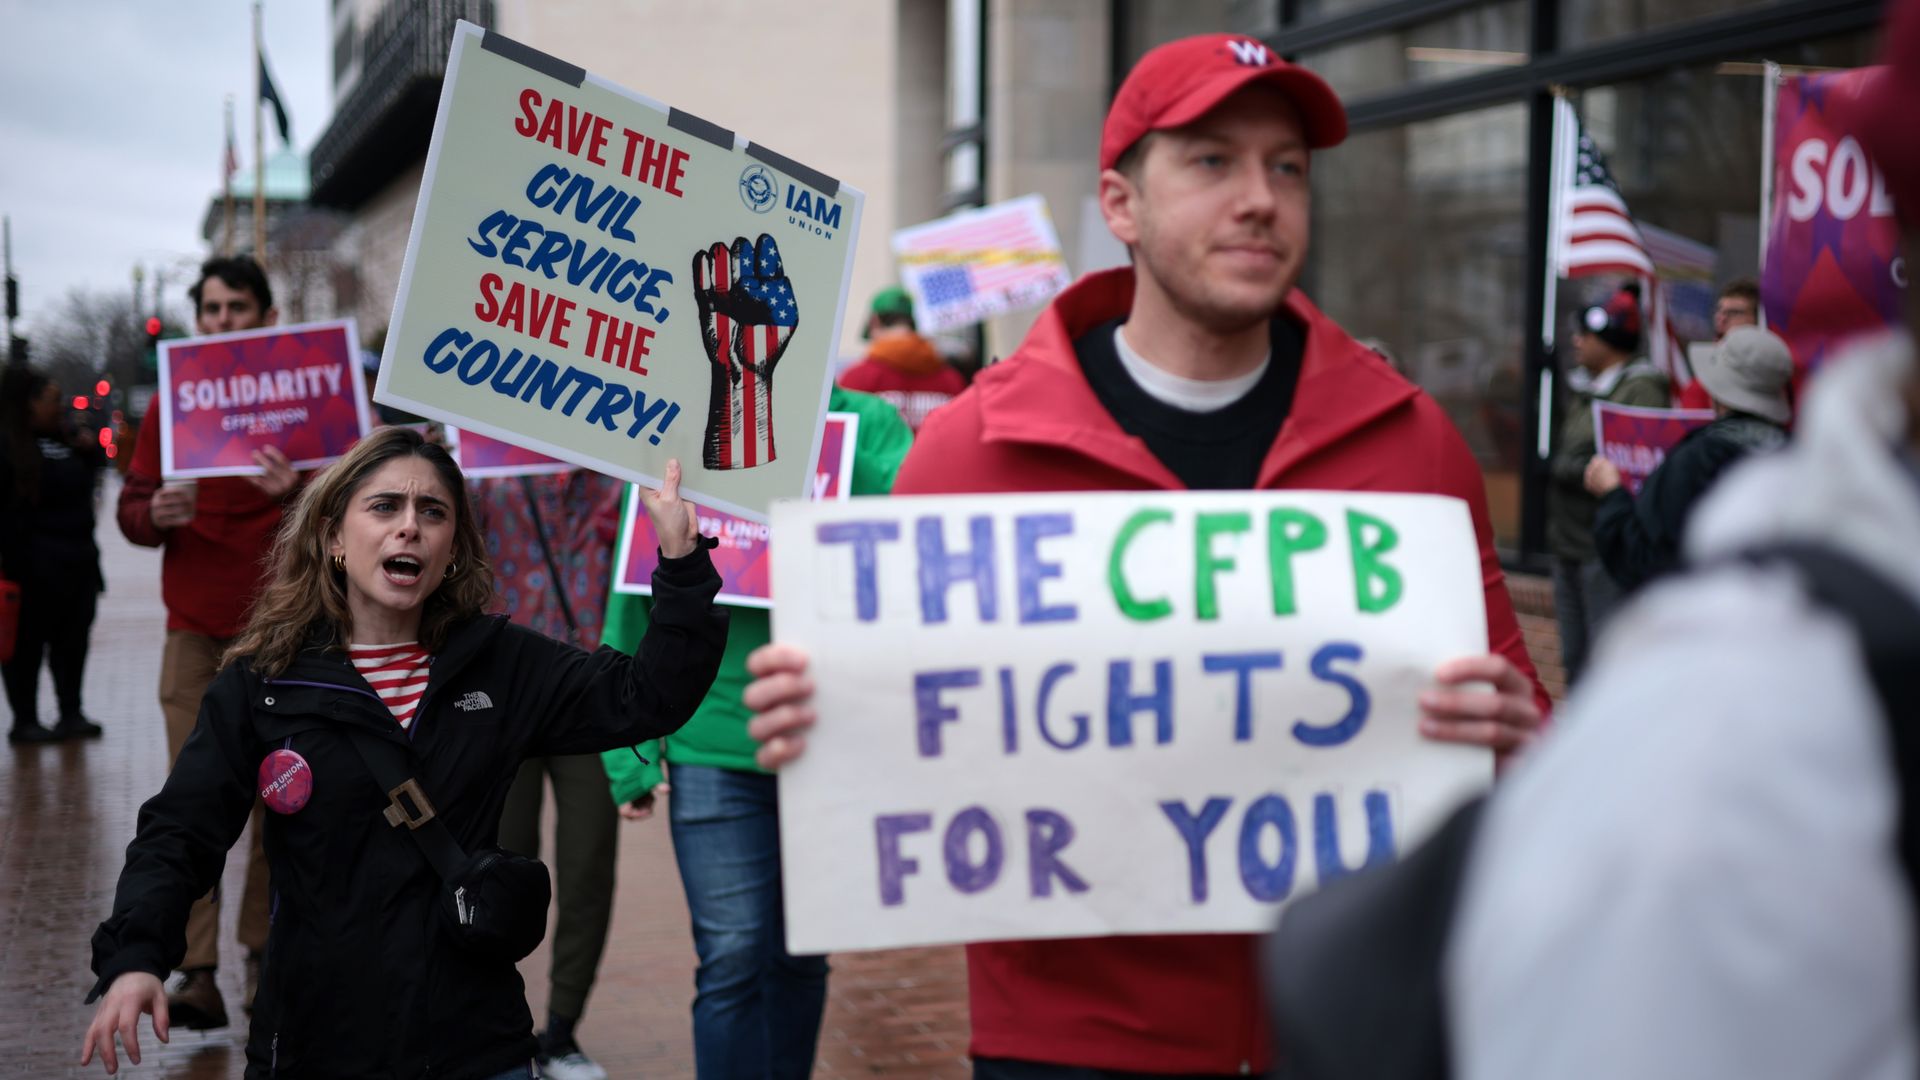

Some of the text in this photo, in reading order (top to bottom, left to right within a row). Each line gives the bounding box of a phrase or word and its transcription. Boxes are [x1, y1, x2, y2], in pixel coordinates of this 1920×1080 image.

[1226, 39, 1267, 66] W
[515, 88, 613, 168] SAVE
[622, 127, 690, 198] THE
[1788, 134, 1896, 222] SOL
[525, 163, 642, 244] CIVIL
[786, 183, 842, 230] IAM
[788, 215, 833, 241] UNION
[467, 209, 675, 325] SERVICE,
[475, 272, 656, 377] SAVE THE
[178, 363, 342, 412] SOLIDARITY
[422, 327, 682, 447] COUNTRY!
[816, 507, 1404, 626] THE CFPB
[913, 641, 1373, 759] FIGHTS
[261, 760, 304, 798] CFPB UNION
[874, 791, 1399, 907] FOR YOU
